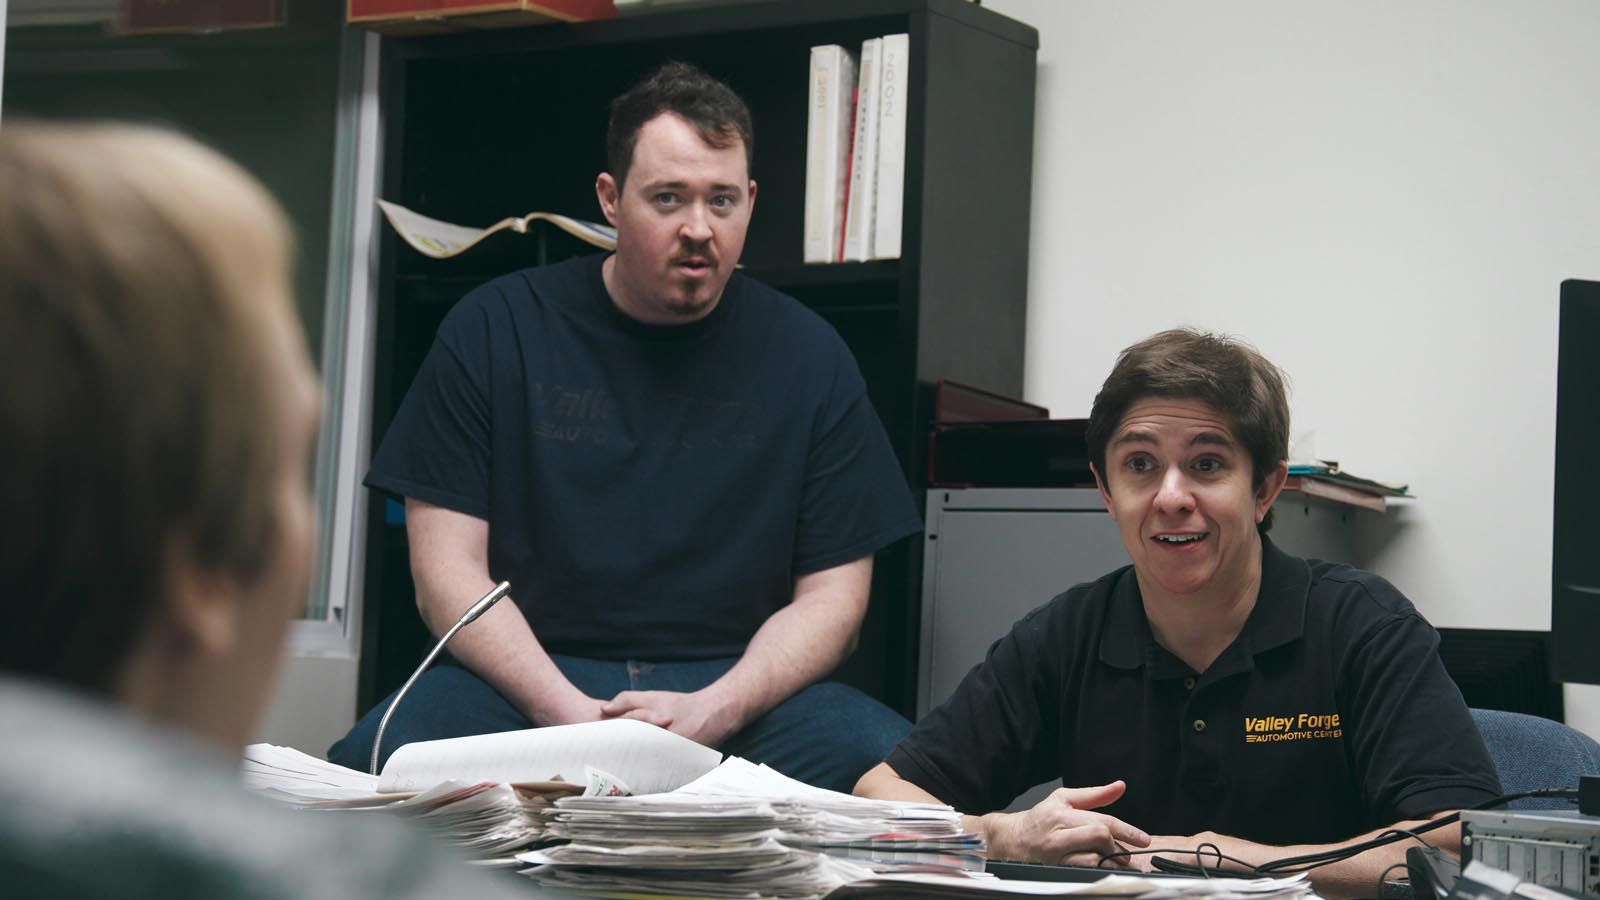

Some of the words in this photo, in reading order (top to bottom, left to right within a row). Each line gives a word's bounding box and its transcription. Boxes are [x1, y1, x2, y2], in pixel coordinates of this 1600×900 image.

[1245, 716, 1294, 732] Valley
[1298, 713, 1340, 729] Forge
[1256, 731, 1312, 743] AUTOMOTIVE
